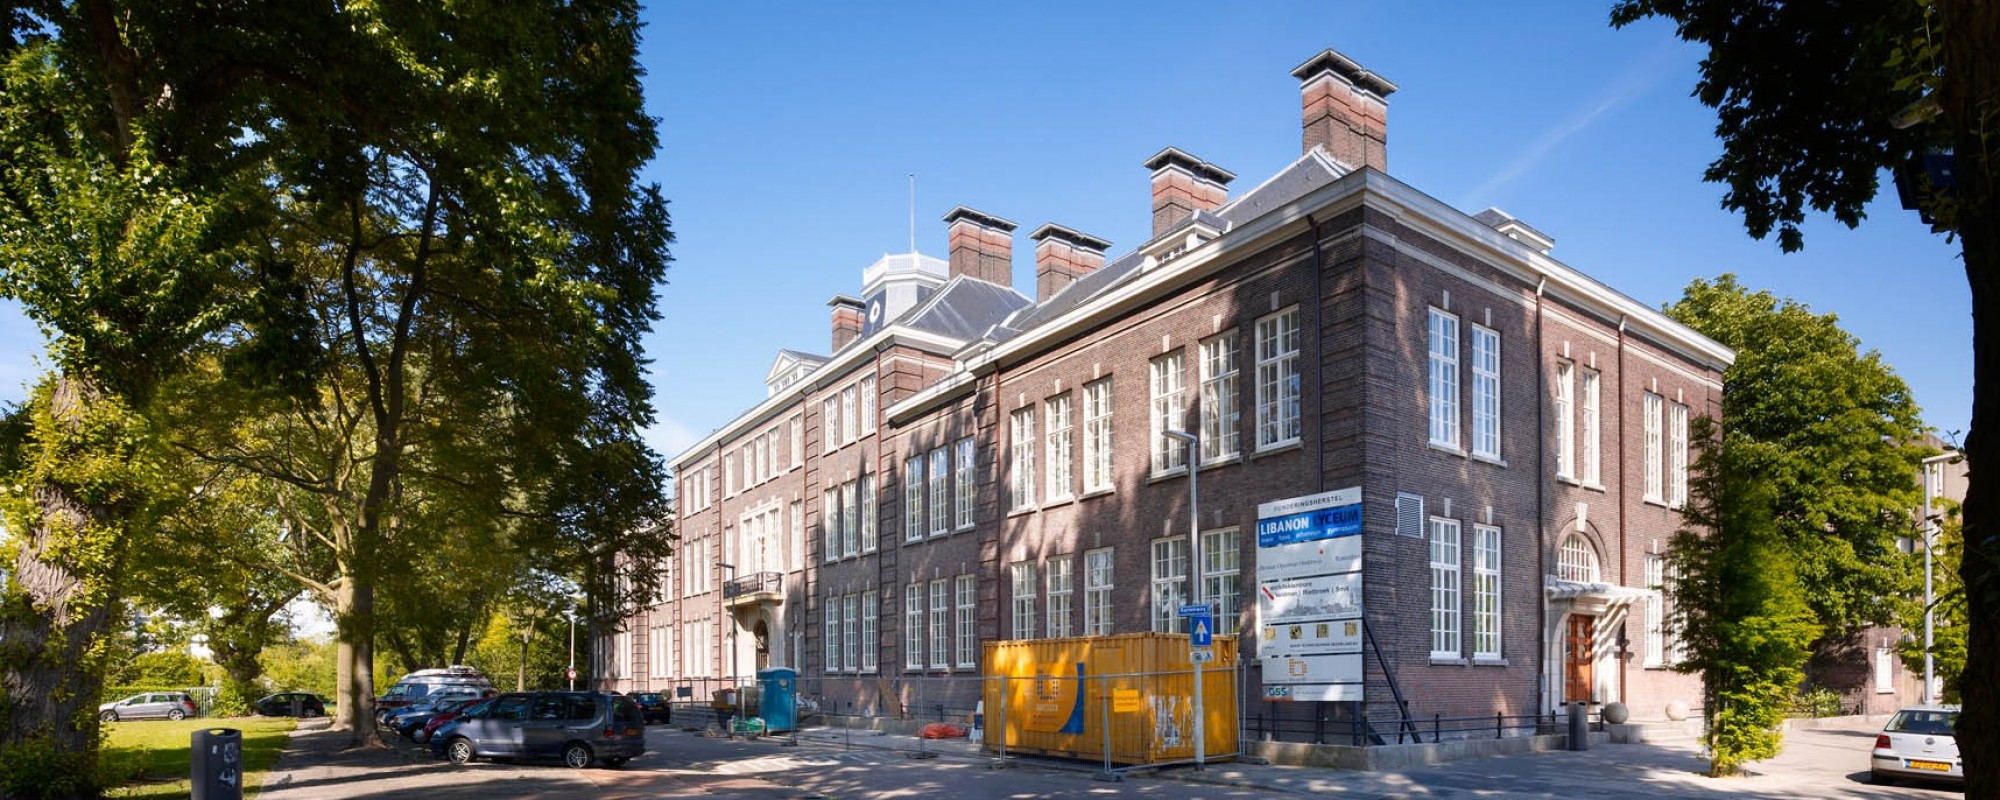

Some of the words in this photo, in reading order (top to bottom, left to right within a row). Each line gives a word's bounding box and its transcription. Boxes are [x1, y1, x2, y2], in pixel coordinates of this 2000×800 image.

[1274, 496, 1342, 511] FUNDERINGSHERSTEL
[1261, 516, 1309, 535] LIBANON
[1313, 509, 1359, 527] LYCEUM
